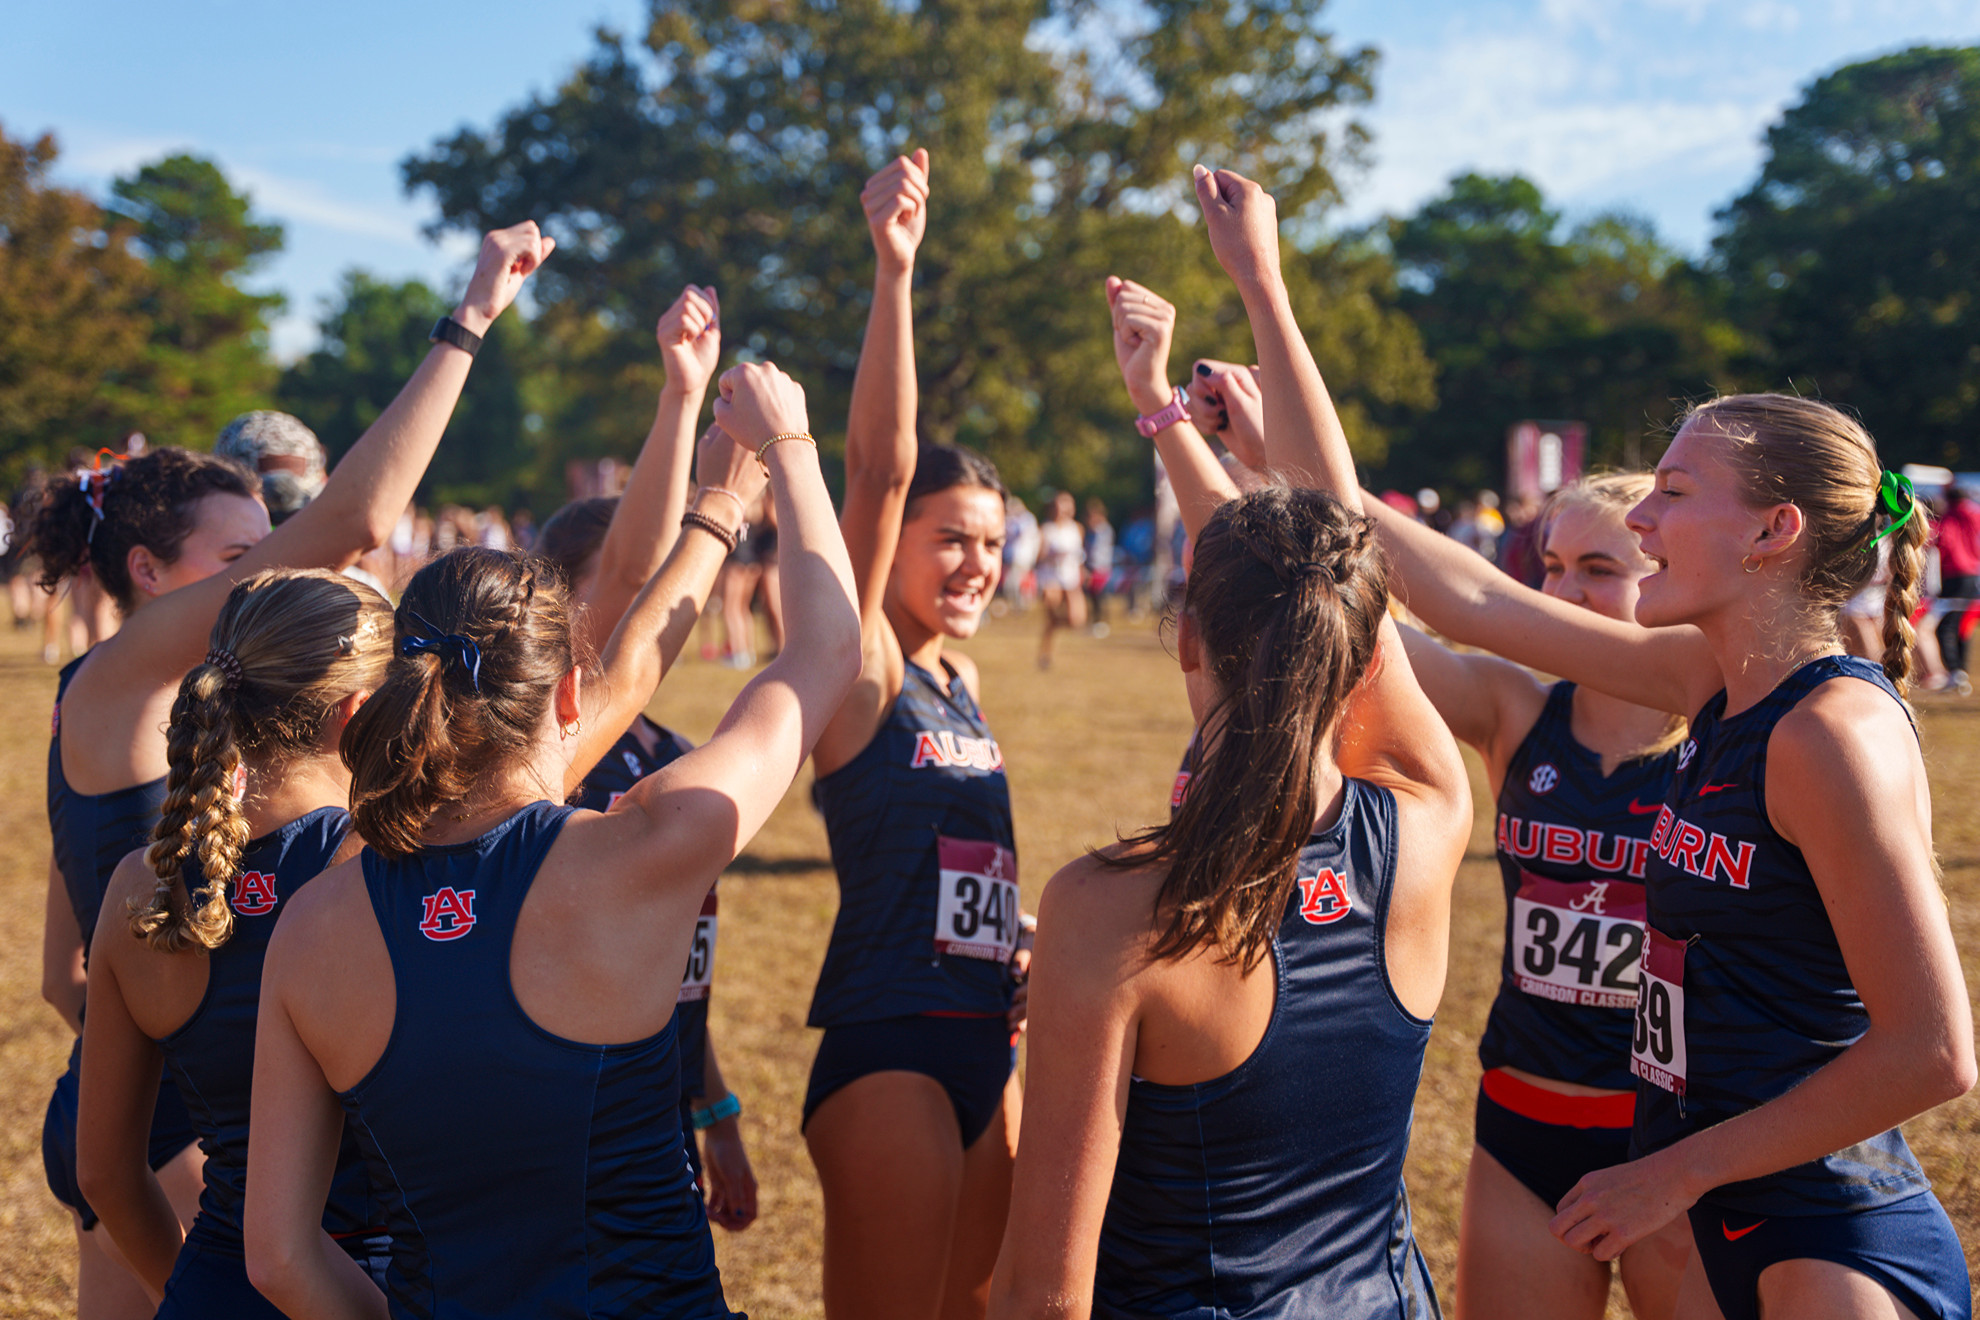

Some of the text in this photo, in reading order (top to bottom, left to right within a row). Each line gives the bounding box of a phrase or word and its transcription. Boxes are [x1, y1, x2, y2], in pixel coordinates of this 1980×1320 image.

[1529, 765, 1558, 794] SEC
[1650, 803, 1757, 890] BURN
[953, 876, 1017, 944] 340
[682, 920, 709, 984] 5
[1523, 908, 1644, 991] 342
[1520, 977, 1578, 1005] CRIMSON
[1640, 1062, 1675, 1093] CLASSIC
